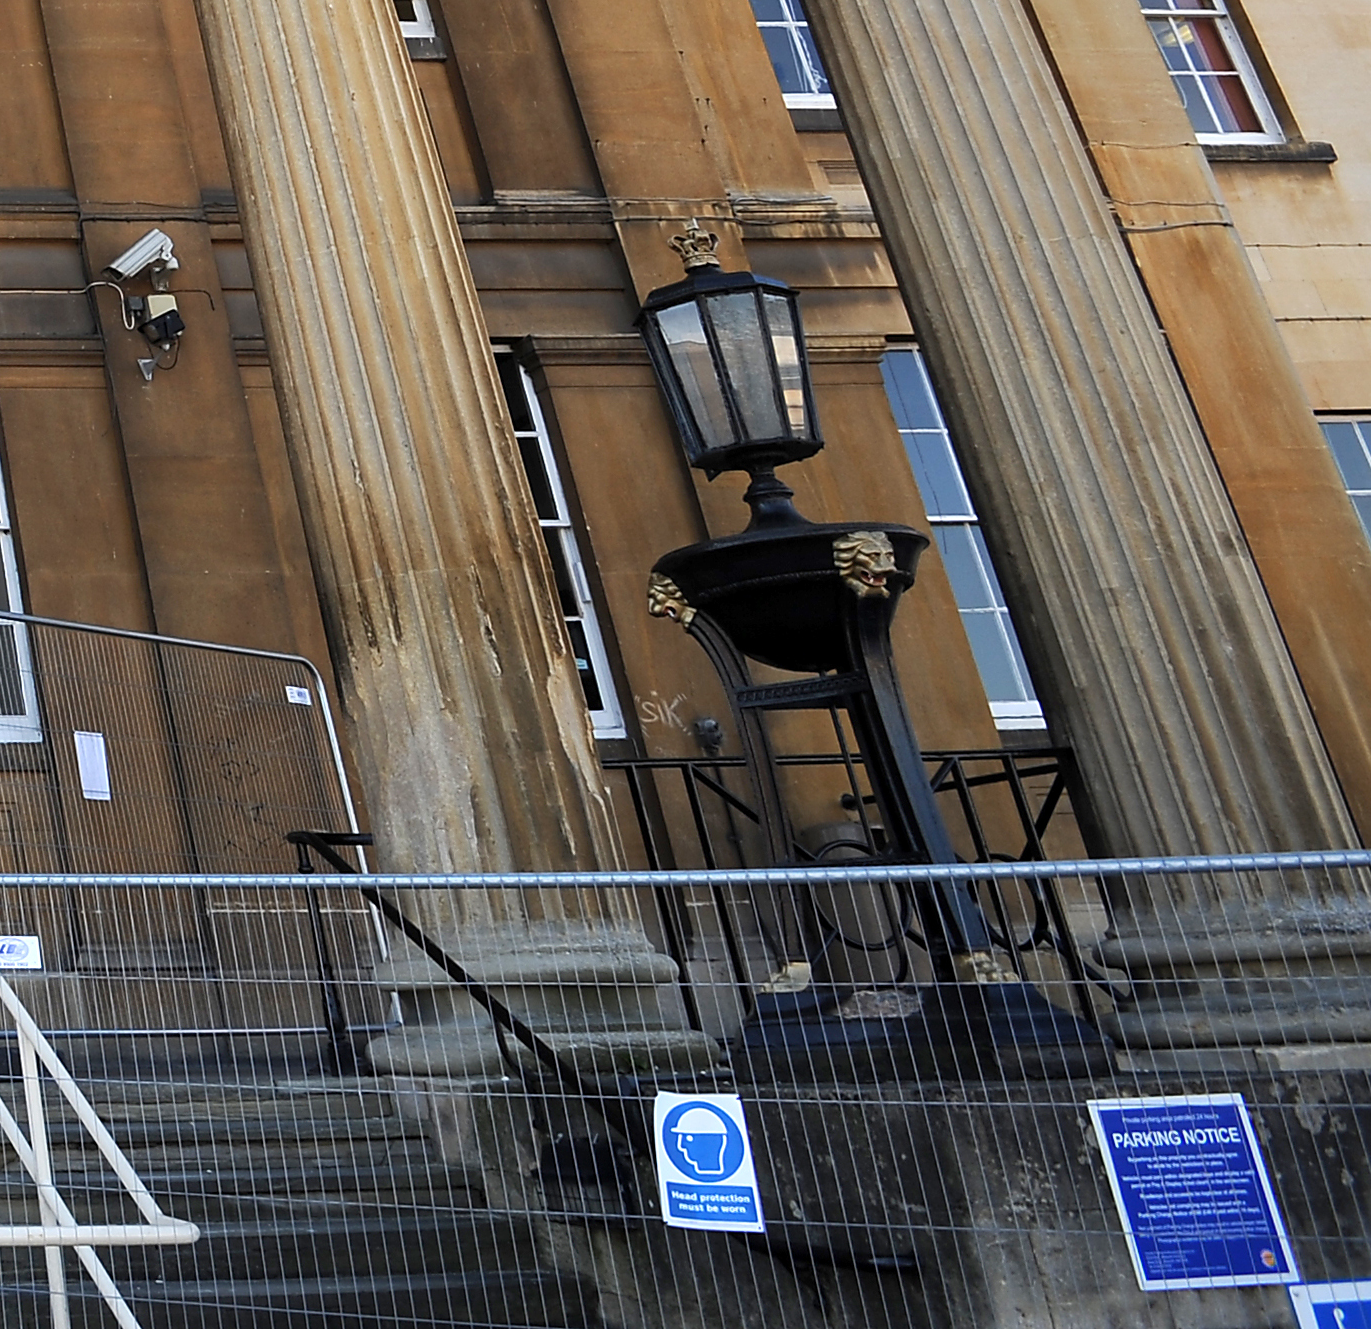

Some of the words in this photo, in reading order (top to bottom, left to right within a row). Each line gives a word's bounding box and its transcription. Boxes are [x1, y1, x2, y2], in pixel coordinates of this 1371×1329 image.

[1112, 1130, 1181, 1148] PARKING
[1184, 1127, 1241, 1144] NOTICE
[671, 1191, 697, 1201] Head
[700, 1194, 750, 1203] protection
[679, 1203, 704, 1211] must
[706, 1204, 719, 1213] be
[721, 1205, 746, 1213] worn
